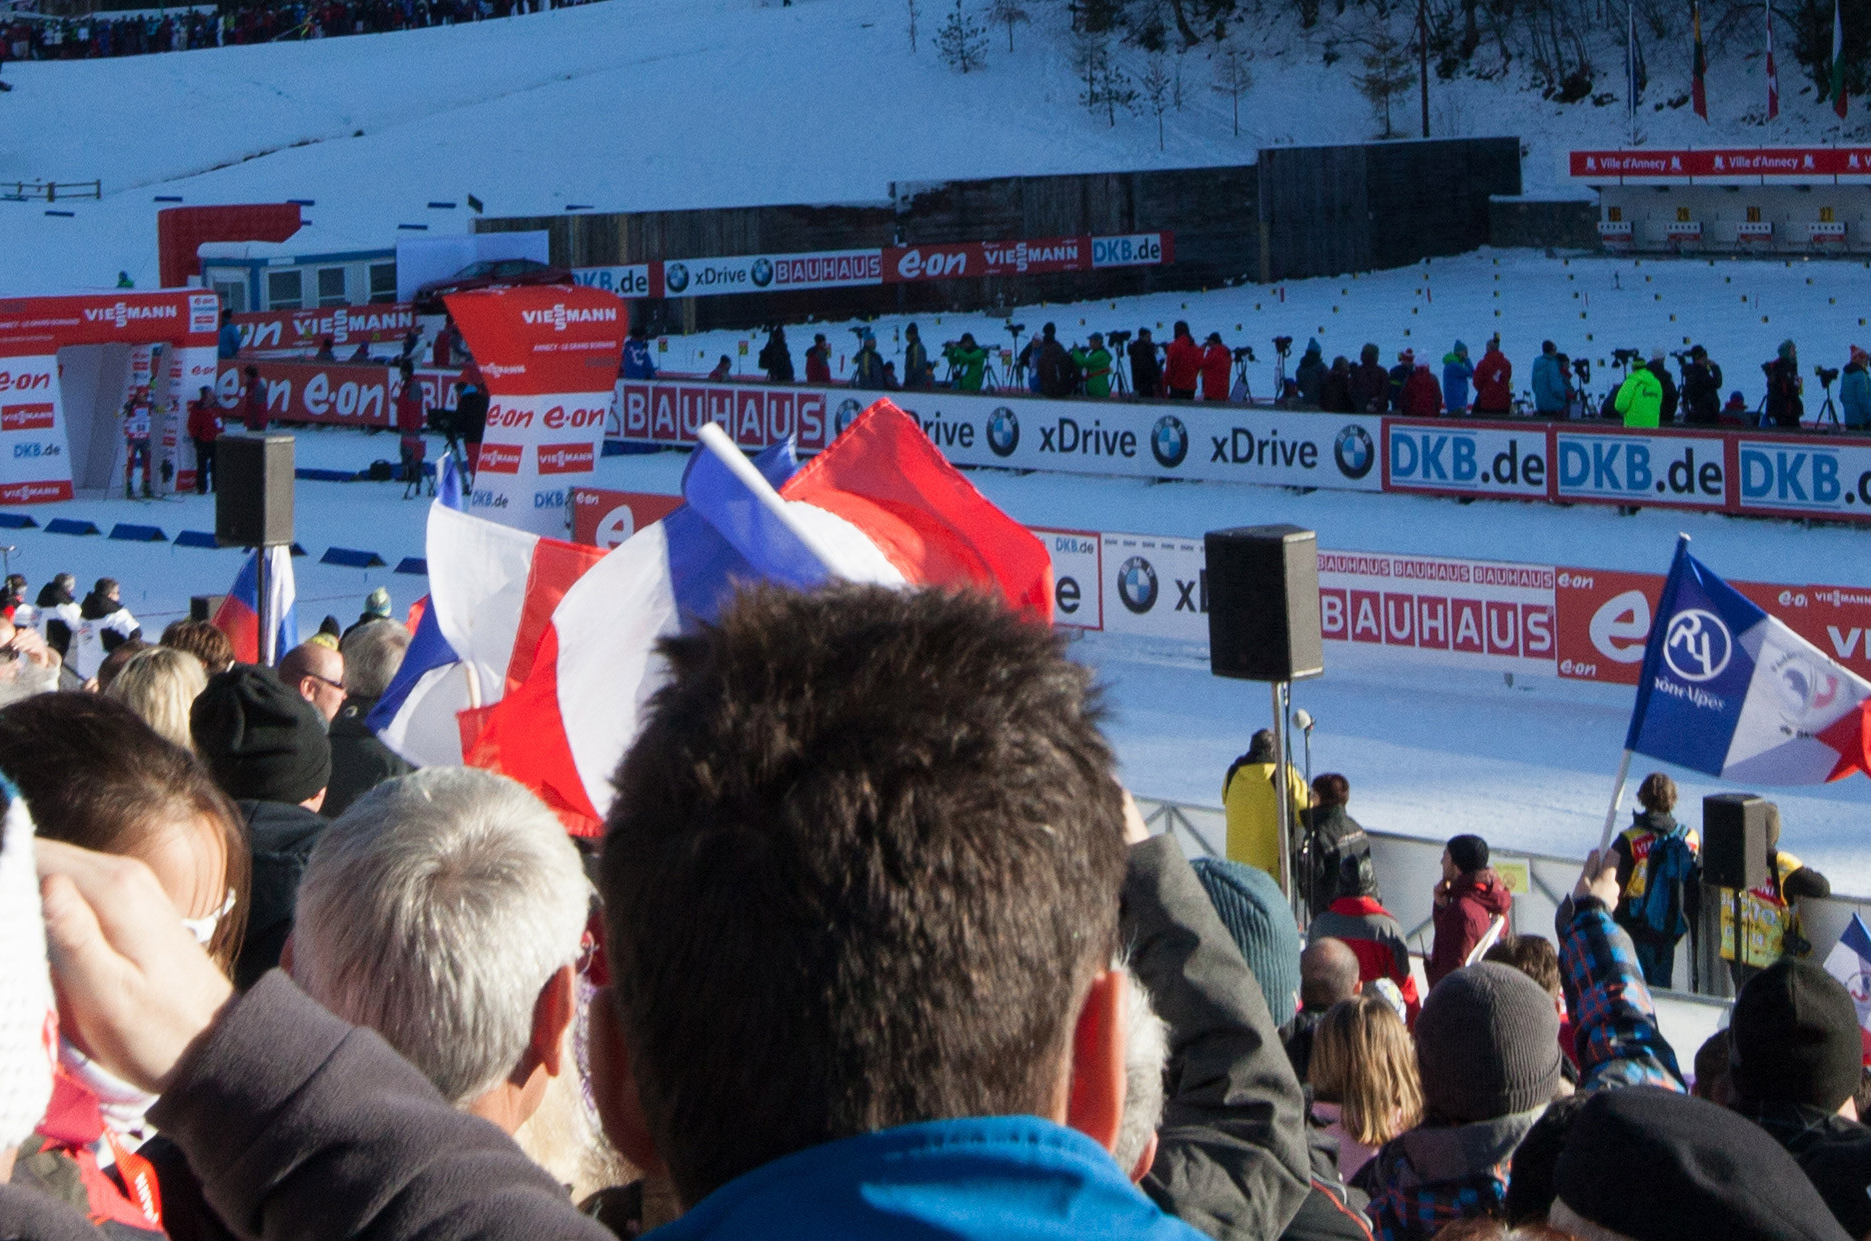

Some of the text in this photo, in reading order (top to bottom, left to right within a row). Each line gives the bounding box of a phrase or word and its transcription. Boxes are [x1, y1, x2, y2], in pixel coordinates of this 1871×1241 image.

[1600, 158, 1666, 171] Ville d'Annecy
[1729, 156, 1798, 170] Ville d'Annecy
[985, 242, 1078, 271] VIESSMANN
[1093, 239, 1160, 265] DKB.de
[695, 267, 746, 286] xDrive
[777, 257, 880, 282] BAUHAUS
[85, 302, 178, 328] VIESSMANN
[293, 310, 414, 343] VIESSMANN
[522, 304, 617, 331] VIESSMANN
[628, 394, 821, 445] BAUHAUS
[909, 411, 974, 448] rive
[14, 443, 60, 458] DKB.de
[1039, 418, 1137, 457] xDrive
[1210, 428, 1318, 468] xDrive
[1391, 434, 1545, 486] DKB.de
[1558, 441, 1723, 495] DKB.de
[1055, 536, 1094, 555] DKB.de
[1317, 555, 1554, 589] BAUHAUS BAUHAUS BAUHAUS
[1321, 595, 1551, 652] BAUHAUS
